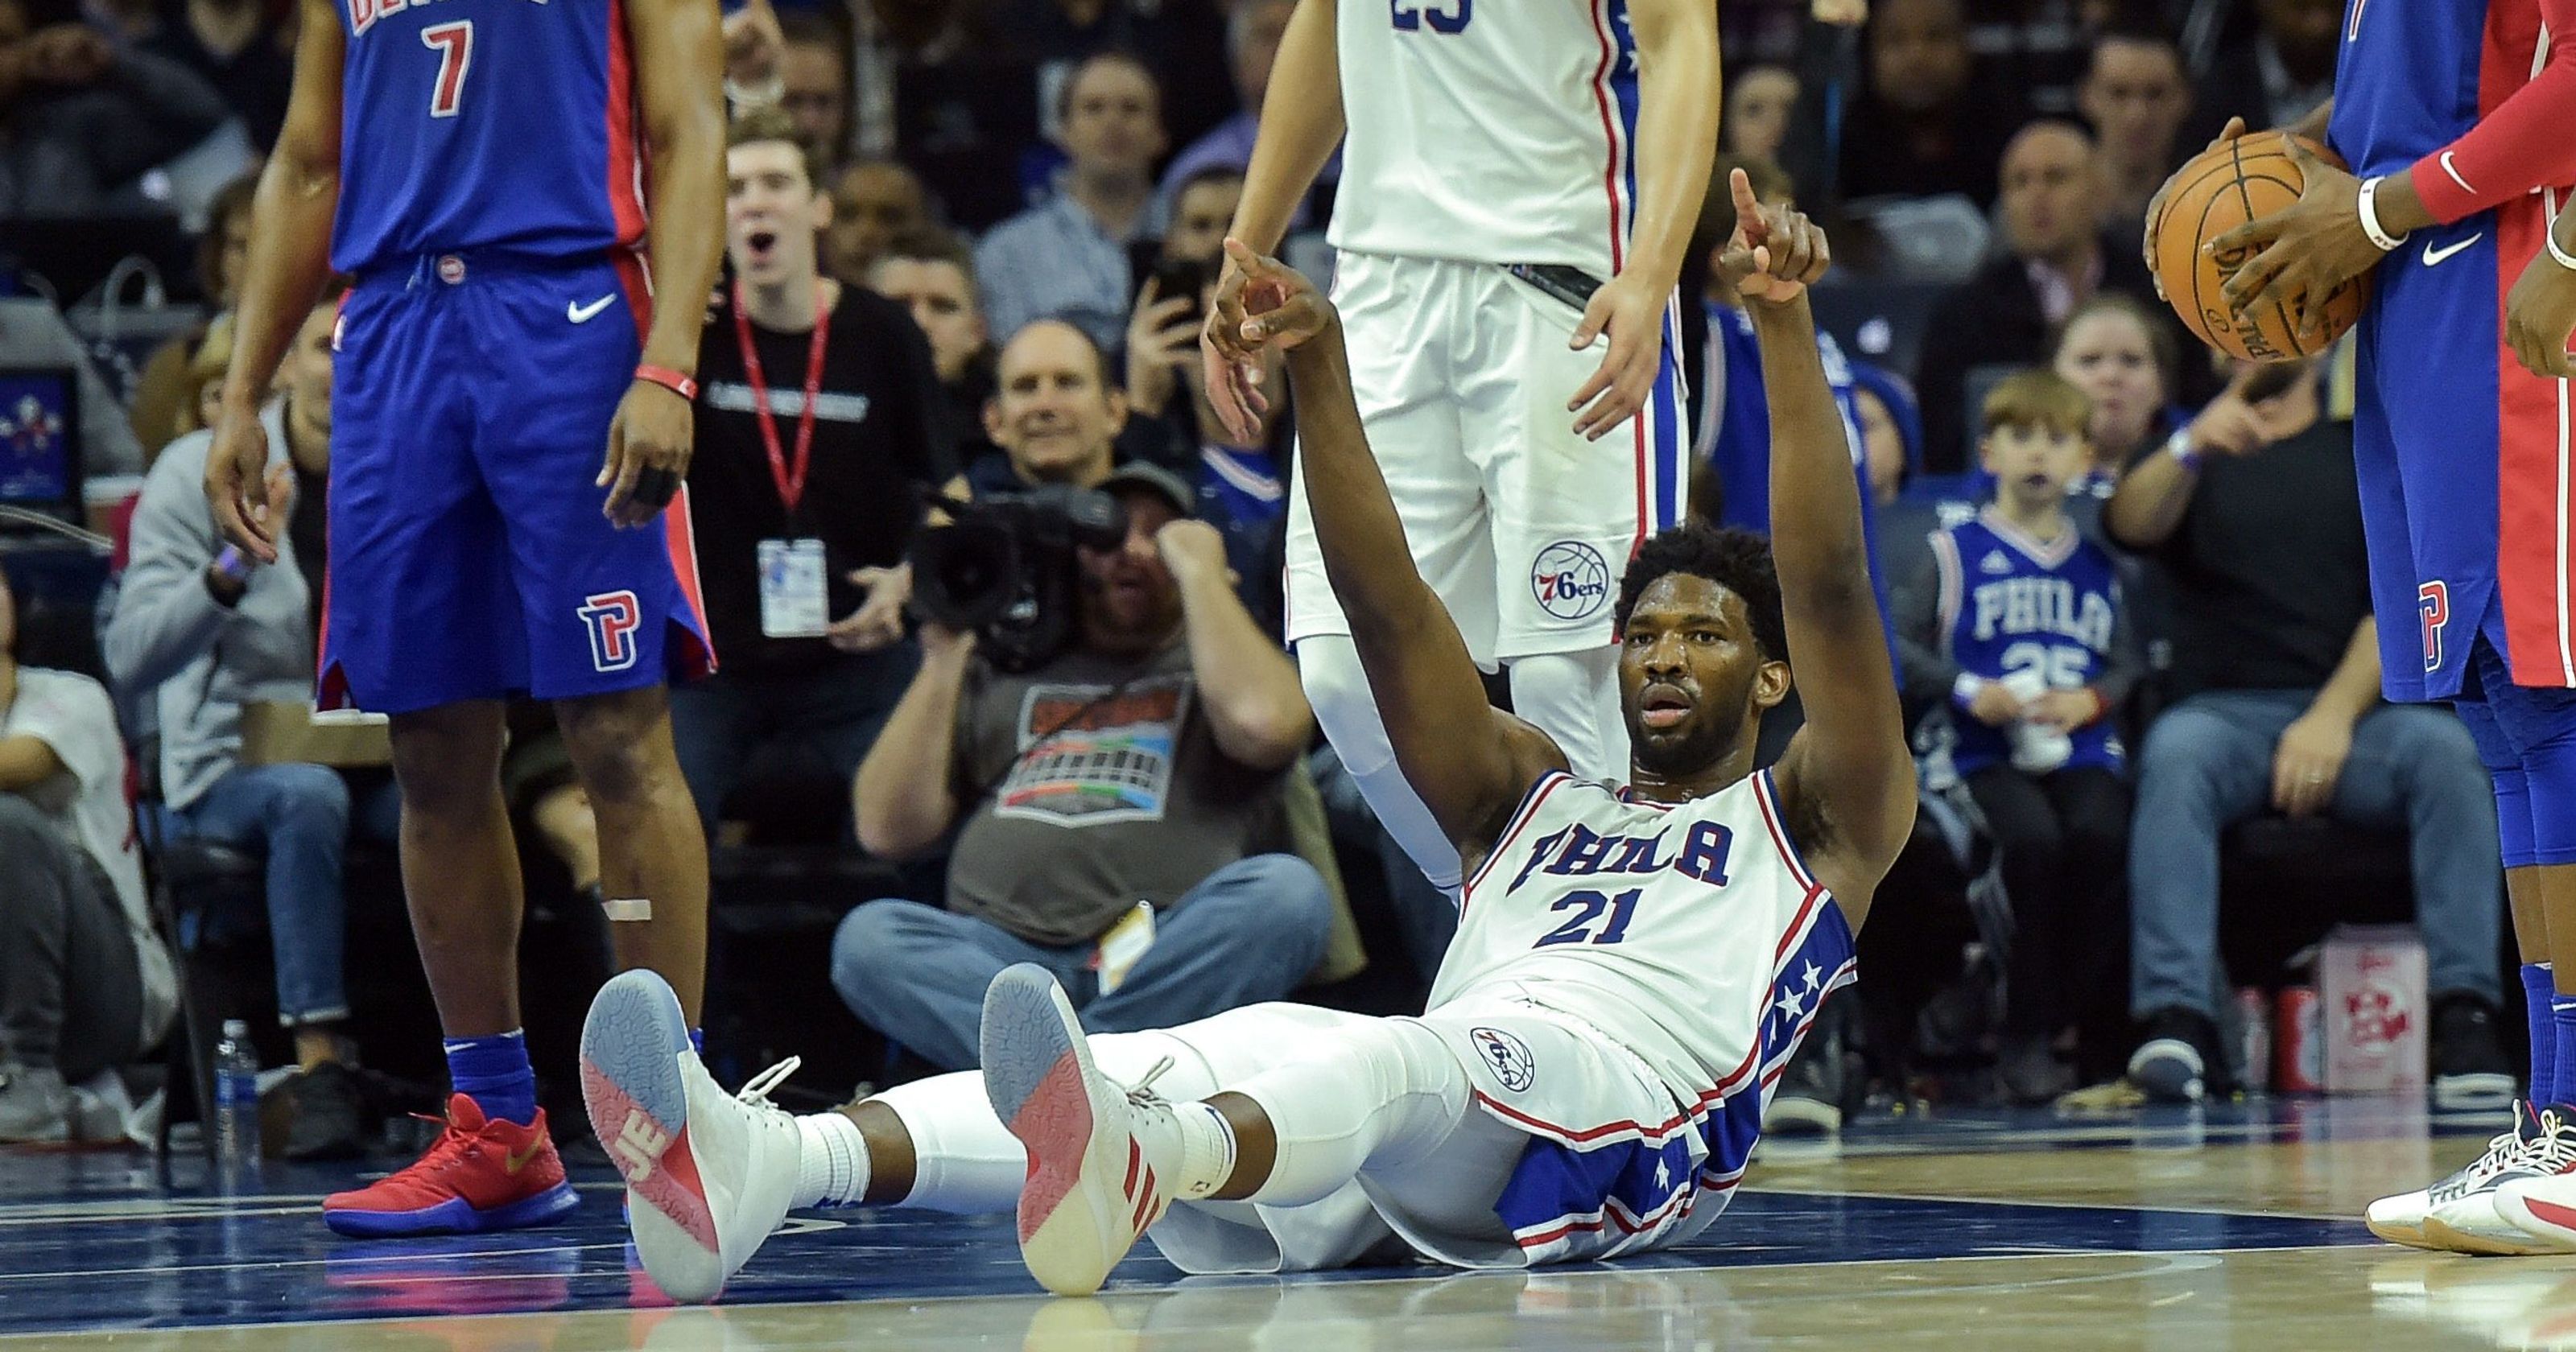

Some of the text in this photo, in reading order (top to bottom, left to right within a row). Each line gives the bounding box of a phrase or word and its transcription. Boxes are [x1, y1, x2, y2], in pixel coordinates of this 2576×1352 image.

[421, 19, 473, 117] 7
[1538, 571, 1604, 601] 76ers
[1974, 575, 2113, 653] PHILA
[1506, 819, 1734, 898] PHILA
[1531, 888, 1644, 950] 21
[615, 1109, 667, 1182] JE
